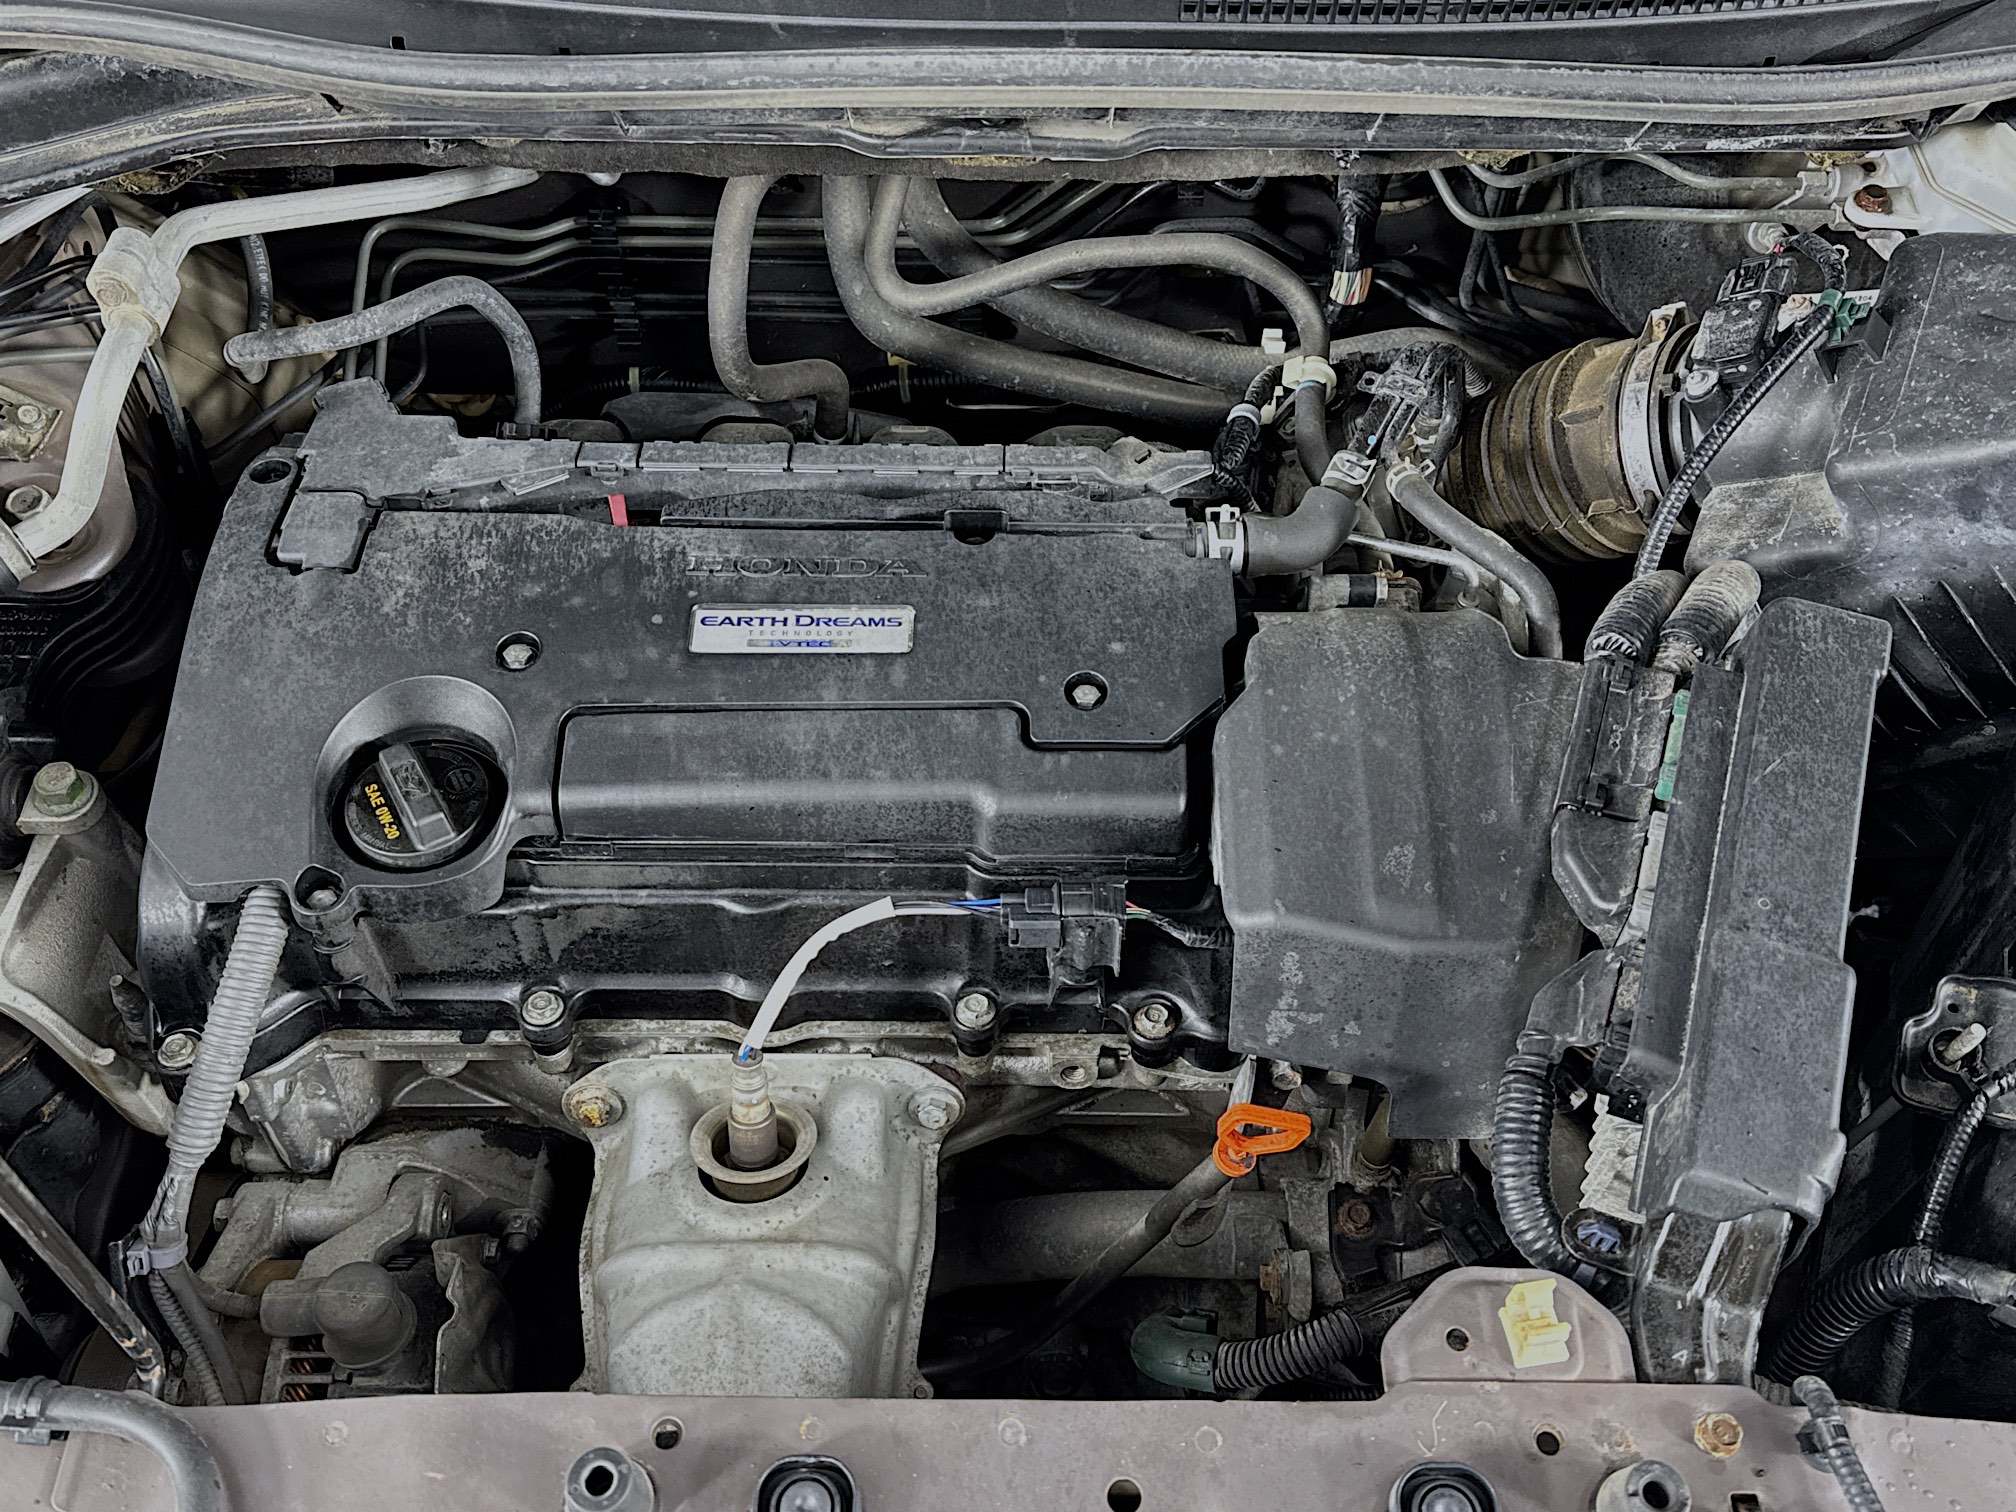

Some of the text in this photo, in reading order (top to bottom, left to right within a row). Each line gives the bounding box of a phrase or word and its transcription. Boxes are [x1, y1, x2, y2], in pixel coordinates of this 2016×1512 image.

[685, 554, 928, 578] HONDA
[700, 615, 788, 627] EARTH
[364, 783, 400, 840] SAE 0W-20
